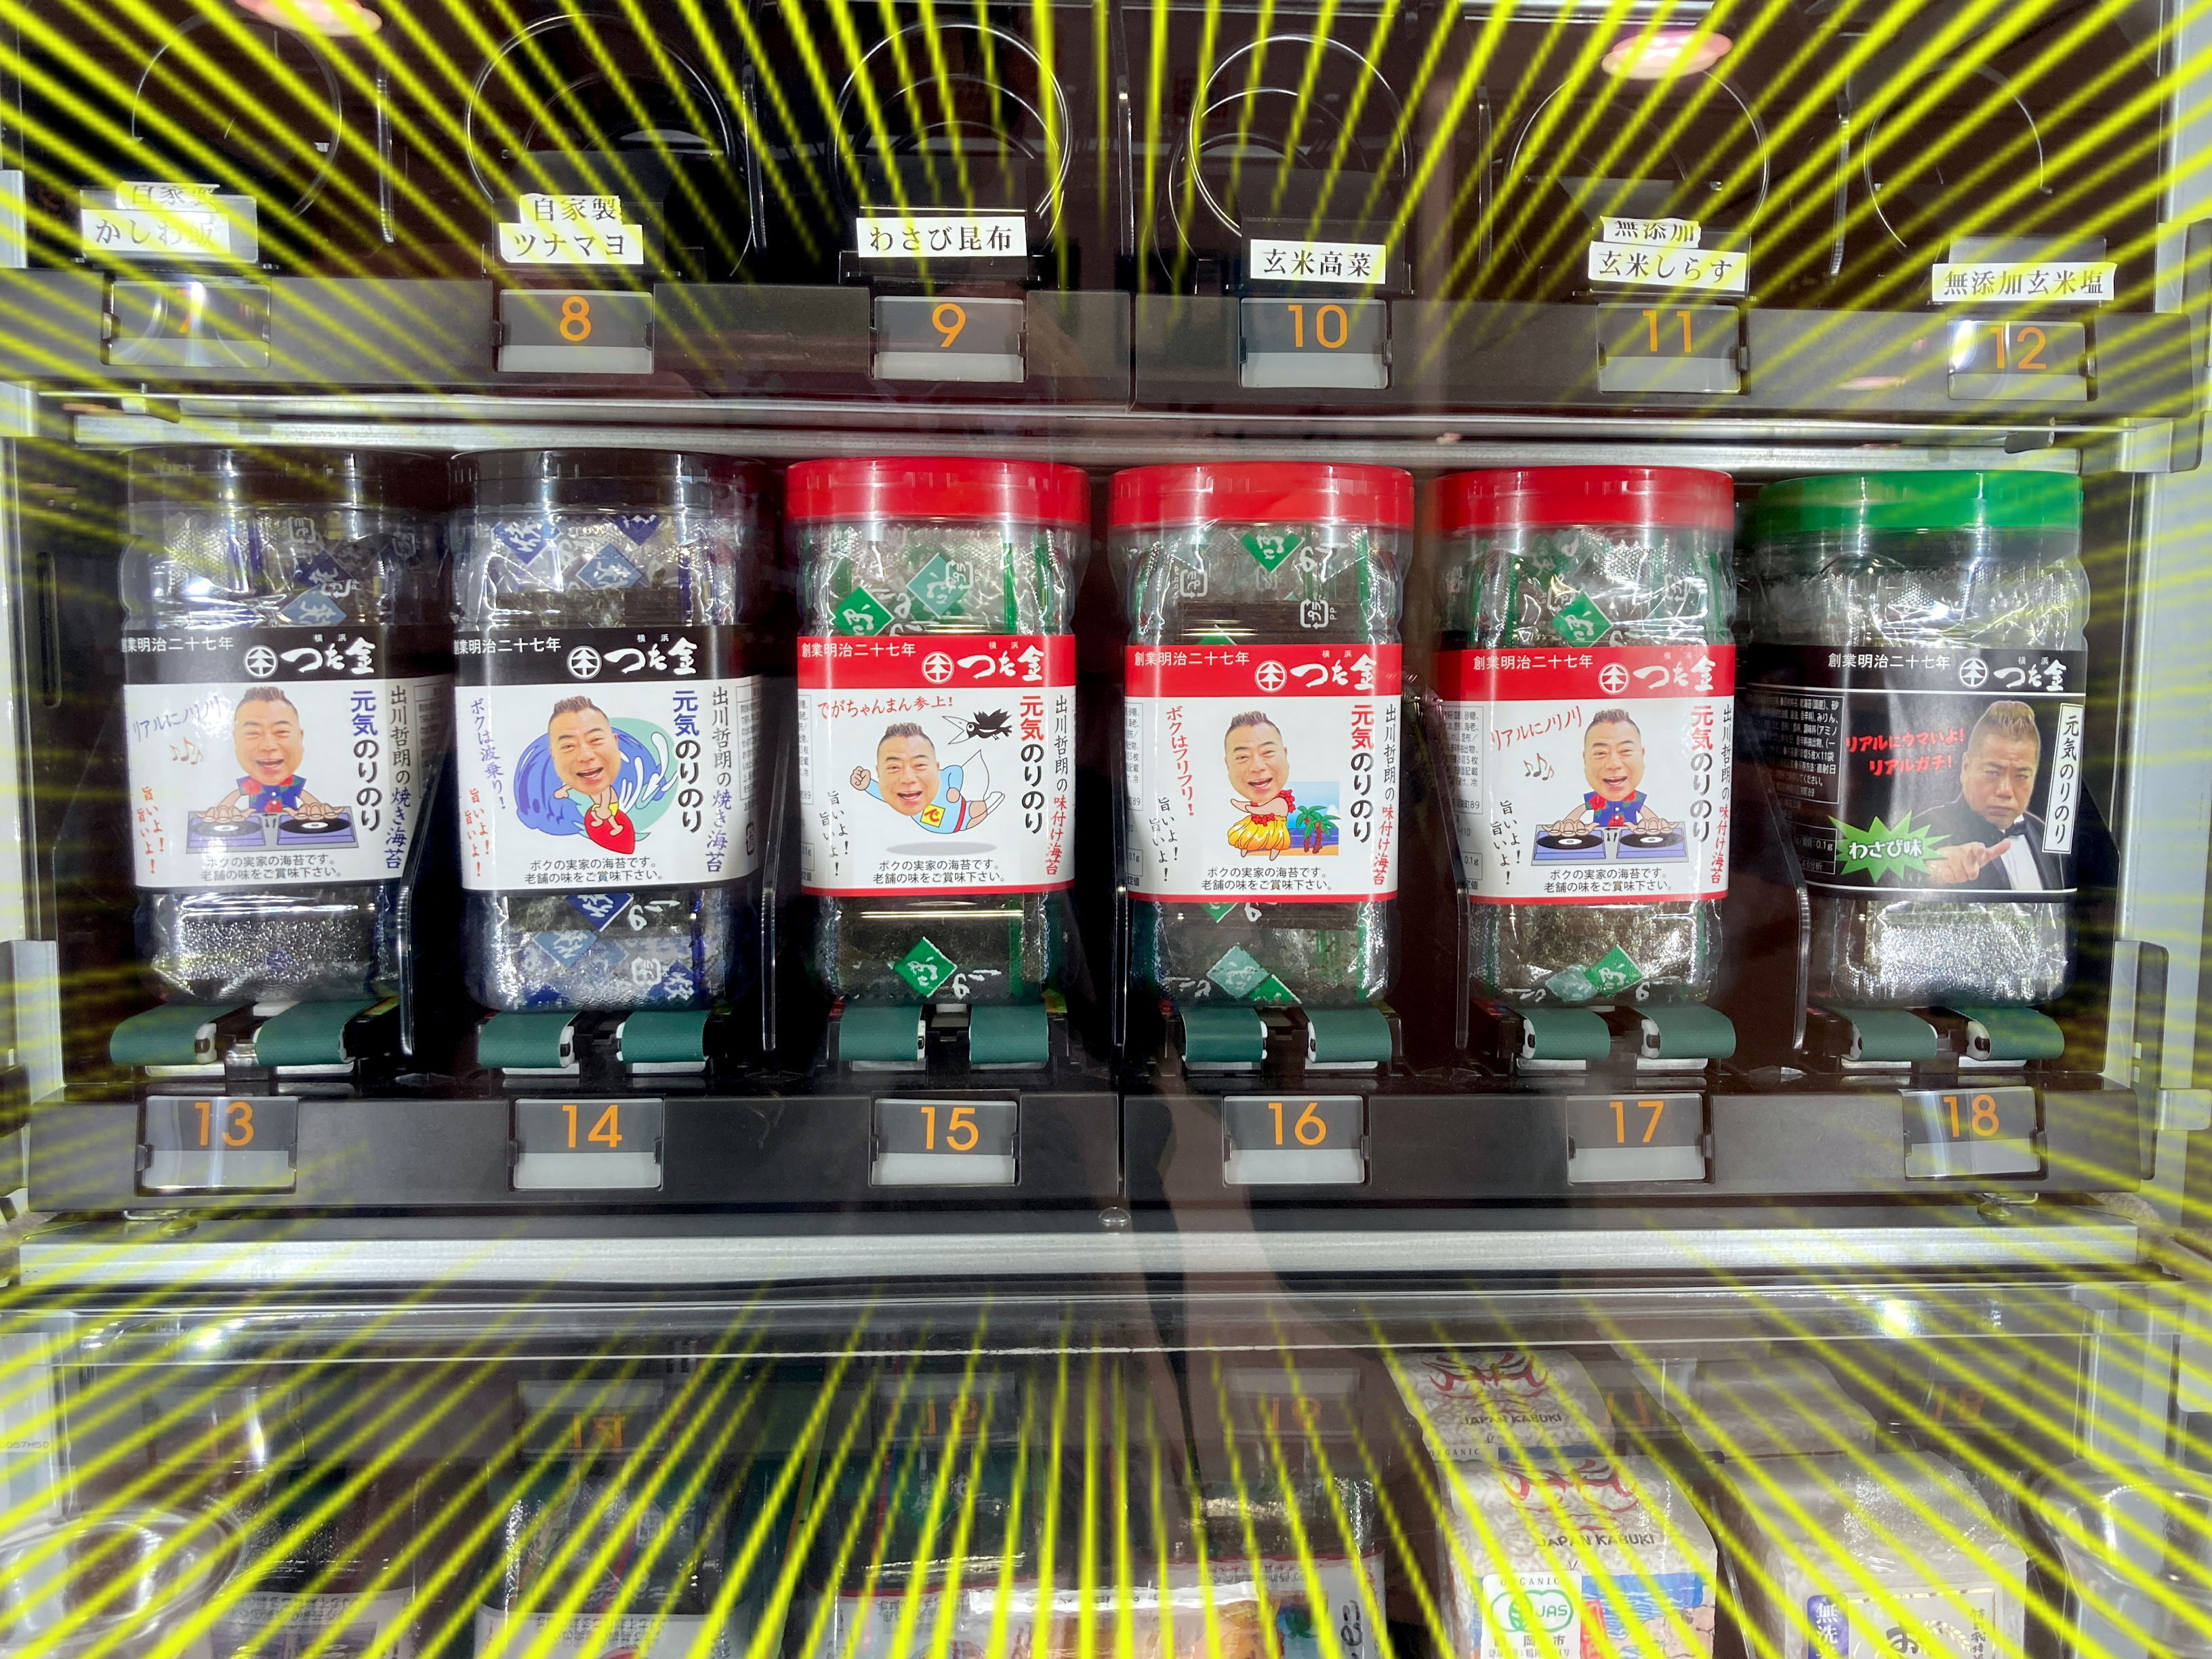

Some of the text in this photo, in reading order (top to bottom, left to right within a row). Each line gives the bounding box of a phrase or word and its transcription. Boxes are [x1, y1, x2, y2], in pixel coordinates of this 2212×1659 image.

[535, 198, 617, 222] 自家製
[96, 219, 216, 247] かしわ飯
[869, 225, 1012, 251] わさび昆布
[1614, 220, 1694, 243] 無添加
[514, 233, 624, 257] ツナマヨ
[1263, 248, 1371, 277] 玄米高菜
[1599, 250, 1732, 283] 玄米しらす
[1944, 269, 2104, 295] 無添加玄米塩
[559, 295, 592, 342] 8
[932, 303, 966, 348] 9
[1288, 304, 1348, 349] 10
[1642, 310, 1692, 352] 11
[1989, 326, 2047, 369] 12
[314, 634, 347, 642] 横浜
[638, 634, 669, 642] 横浜
[802, 642, 916, 658] 創業明治二十七年
[989, 641, 1019, 649] 横浜
[1134, 651, 1250, 666] 創業明治二十七年
[1322, 649, 1351, 658] 横浜
[1473, 654, 1593, 670] 創業明治二十七年
[1828, 653, 1950, 670] 創業明治二十七年
[2018, 656, 2049, 665] 横浜
[351, 690, 382, 831] 元気のりのり
[673, 690, 703, 833] 元気のりのり
[1019, 695, 1045, 834] 元気のりのり
[1868, 754, 1952, 776] リアルガチ！
[385, 685, 411, 869] 出川哲朗の焼き海苔
[706, 687, 732, 873] 出川哲朗の焼き海苔
[1045, 695, 1069, 876] 出川哲朗の味付け海苔
[1351, 704, 1376, 843] 元気のりのり
[1690, 705, 1714, 843] 元気のりのり
[2053, 715, 2079, 844] 元気のりのり
[1372, 703, 1397, 885] 出川哲朗の味付け海苔
[1711, 704, 1732, 884] 出川哲朗の味付け海苔
[207, 853, 336, 867] ボクの実家の海苔です。
[1848, 838, 1923, 861] わさび味
[201, 867, 342, 880] 老舗の味をご賞味下さい。
[530, 856, 655, 869] ボクの実家の海苔です。
[879, 859, 1000, 871] ボクの実家の海苔です。
[1207, 867, 1327, 878] ボクの実家の海苔です。
[1551, 867, 1667, 879] ボクの実家の海苔です。
[525, 869, 662, 884] 老舗の味をご賞味下さい。
[873, 871, 1004, 884] 老舗の味をご賞味下さい。
[1201, 878, 1332, 891] 老舗の味をご賞味下さい。
[1544, 879, 1673, 893] 老舗の味をご賞味下さい。
[194, 1101, 255, 1147] 13
[562, 1105, 623, 1148] 14
[1268, 1102, 1327, 1146] 16
[1609, 1100, 1664, 1144] 17
[1943, 1093, 2000, 1138] 18
[921, 1106, 979, 1151] 15
[1512, 1414, 1561, 1423] KABUKI
[1597, 1534, 1655, 1546] KABUKI
[1536, 1605, 1568, 1617] JAS
